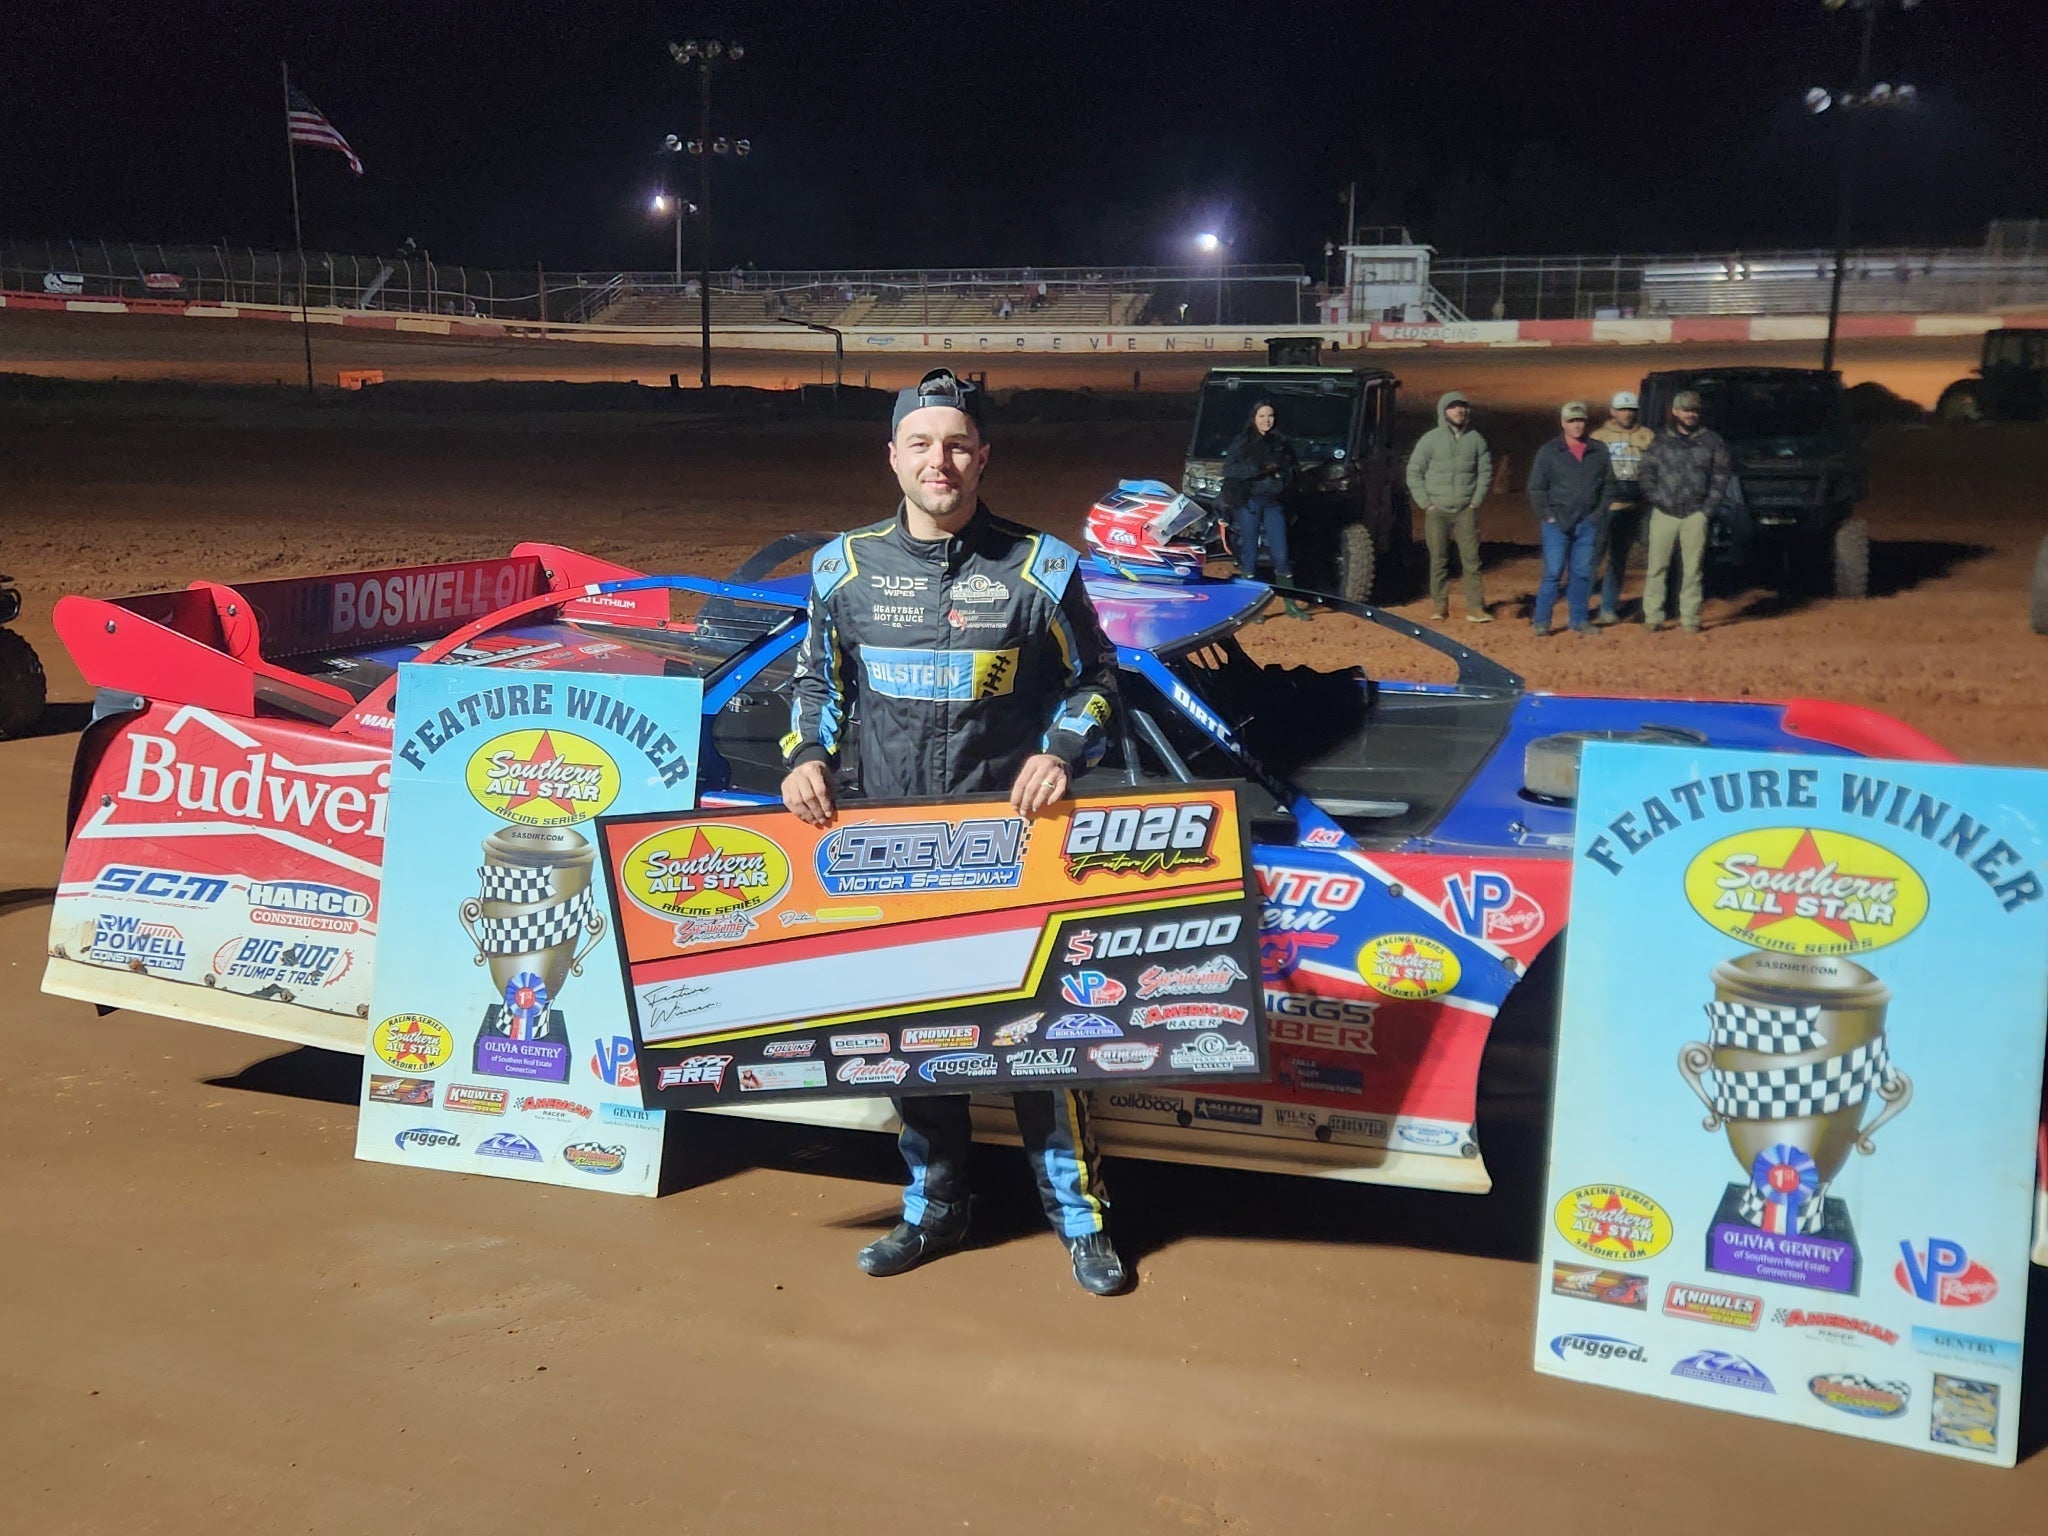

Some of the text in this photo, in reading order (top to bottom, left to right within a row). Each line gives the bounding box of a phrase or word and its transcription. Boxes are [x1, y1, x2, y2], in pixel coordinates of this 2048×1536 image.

[1393, 325, 1478, 340] FLORACING
[871, 576, 929, 590] DUDE
[884, 589, 916, 597] WIPES
[333, 567, 488, 634] BOSWELL
[593, 597, 636, 609] LITHIUM
[873, 604, 925, 615] HEARTBEAT
[873, 613, 924, 623] HOT SAUCE
[869, 660, 960, 688] BILSTEIN
[399, 683, 690, 789] FEATURE WINNER
[486, 750, 602, 784] Southern
[118, 733, 389, 838] Budwei
[485, 778, 600, 802] ALL STAR
[495, 806, 587, 825] RACING SERIES
[511, 831, 565, 842] SASDIRT.COM
[1065, 803, 1214, 854] 2026
[830, 819, 1021, 872] SCREVEN
[1585, 769, 2045, 914] FEATURE WINNER
[645, 846, 766, 878] Southern
[1071, 851, 1211, 877] Feature Winner
[649, 871, 768, 894] ALL STAR
[838, 870, 1015, 892] MOTOR SPEEDWAY
[1715, 854, 1897, 903] Southern
[250, 883, 369, 917] HARCO
[662, 896, 761, 916] RACING SERIES
[1445, 873, 1512, 940] VP
[1714, 889, 1895, 926] ALL STAR
[97, 913, 141, 933] RW
[252, 910, 354, 932] CONSTRUCTION
[1487, 909, 1541, 934] Racing
[94, 931, 186, 957] POWELL
[1064, 914, 1244, 965] $10,000
[1376, 936, 1446, 955] RACING SERIES
[1730, 926, 1873, 952] RACING SERIES
[236, 938, 283, 965] BIG
[1374, 947, 1443, 970] Southern
[228, 963, 275, 981] STUMP
[1372, 963, 1445, 982] ALL STAR
[1755, 960, 1838, 976] SASDIRT.COM
[1061, 971, 1106, 1005] VP
[1377, 981, 1439, 998] SASDIRT.COM
[388, 1016, 442, 1032] RACING SERIES
[1144, 1003, 1248, 1025] AMERICAN
[1168, 1019, 1218, 1028] RACER
[387, 1026, 440, 1046] Southern
[835, 1038, 885, 1048] DELPH
[906, 1028, 973, 1044] KNOWLES
[1055, 1028, 1116, 1037] ROCKAUTO.COM
[1267, 1019, 1369, 1049] BER
[385, 1041, 440, 1057] ALL STAR
[484, 1041, 562, 1059] OLIVIA GENTRY
[766, 1043, 812, 1055] COLLINS
[387, 1056, 436, 1070] SASDIRT.COM
[498, 1056, 523, 1065] Southern
[535, 1060, 553, 1068] Estate
[505, 1065, 537, 1075] Connection
[594, 1035, 635, 1086] VP
[839, 1057, 908, 1081] Gentry
[1011, 1066, 1077, 1077] CONSTRUCTION
[662, 1067, 722, 1085] SRE
[449, 1088, 504, 1102] KNOWLES
[521, 1096, 593, 1120] AMERICAN
[542, 1110, 566, 1118] RACER
[613, 1108, 651, 1121] GENTRY
[1575, 1186, 1655, 1212] RACING SERIES
[1573, 1200, 1653, 1230] Southern
[1571, 1220, 1654, 1243] ALL STAR
[1574, 1238, 1648, 1259] SASDIRT.COM
[1723, 1230, 1846, 1263] OLIVIA GENTRY
[1734, 1250, 1744, 1259] of
[1744, 1253, 1783, 1267] Southern
[1756, 1265, 1806, 1281] Connection
[1899, 1237, 1968, 1304] VP
[1671, 1288, 1755, 1312] KNOWLES
[1941, 1278, 1997, 1303] Racing
[1785, 1309, 1900, 1346] AMERICAN
[1818, 1329, 1855, 1341] RACER
[1934, 1335, 1998, 1355] GENTRY
